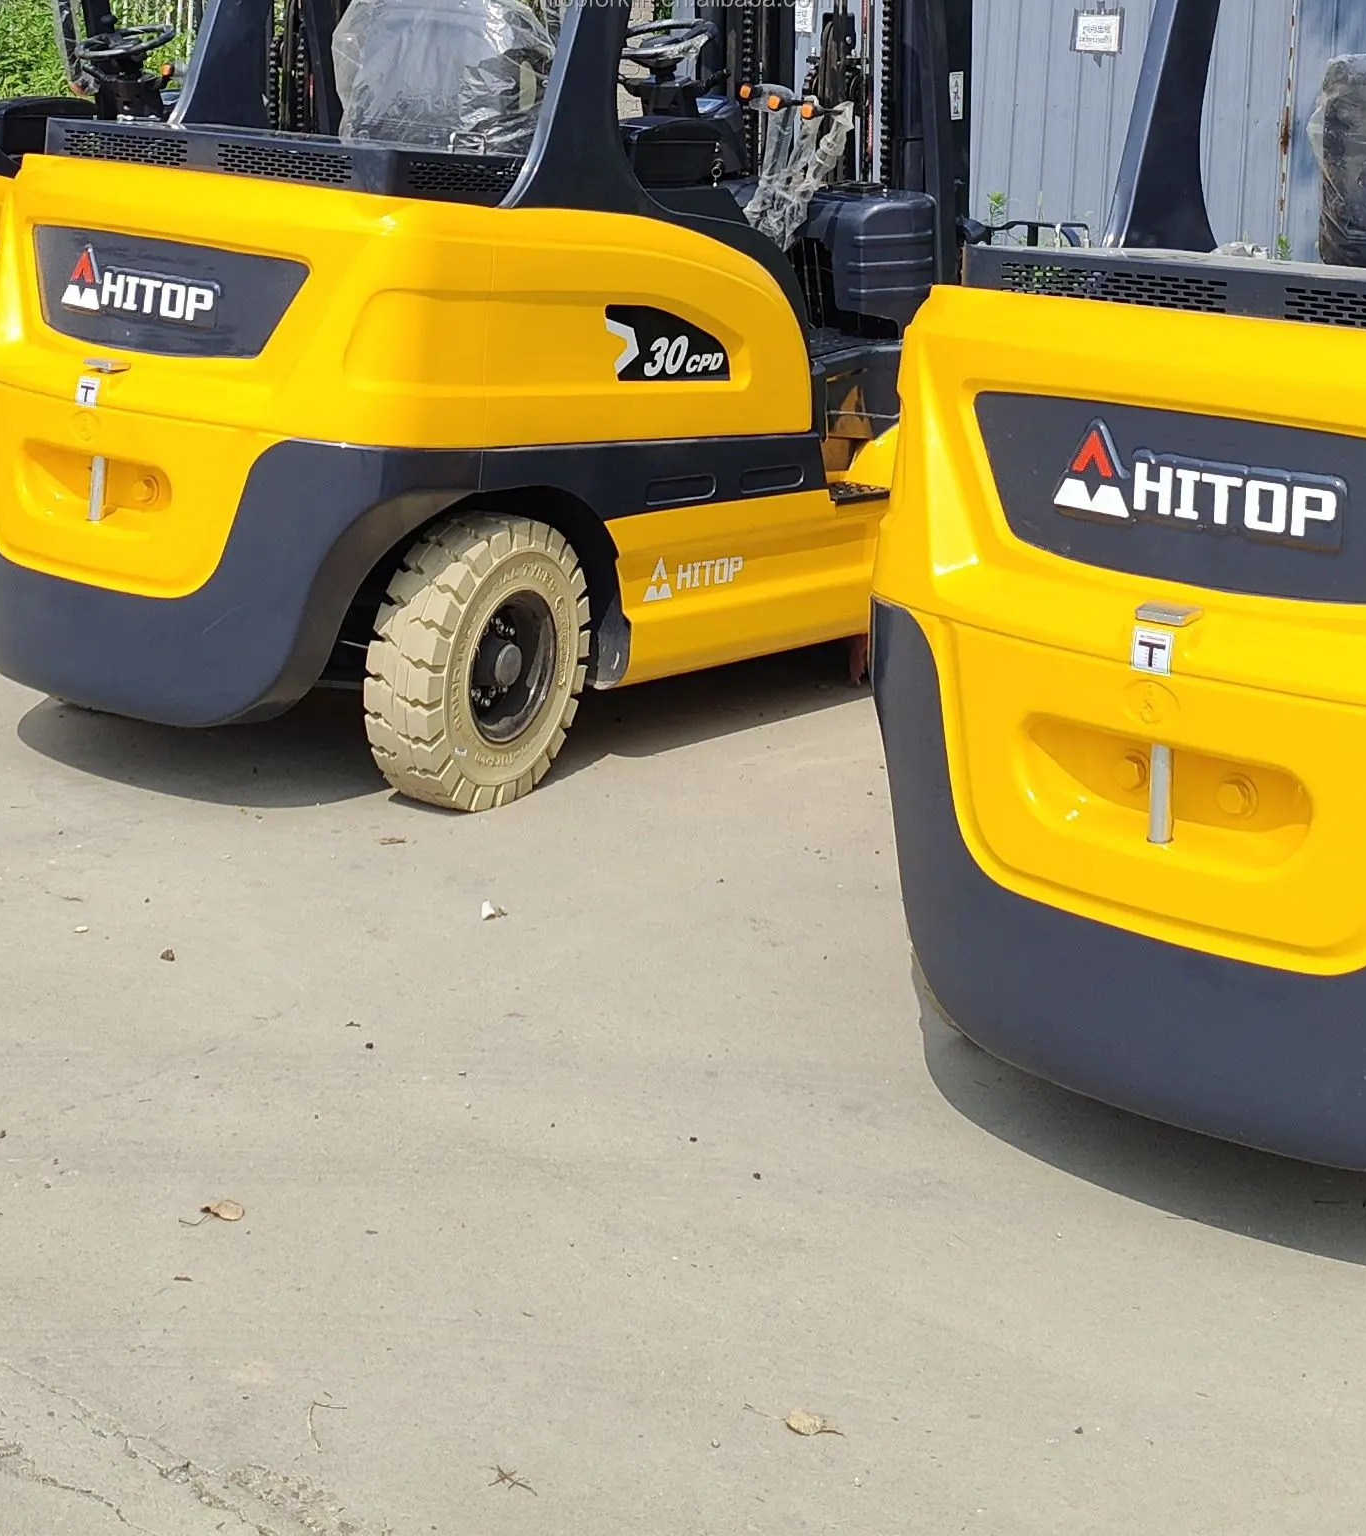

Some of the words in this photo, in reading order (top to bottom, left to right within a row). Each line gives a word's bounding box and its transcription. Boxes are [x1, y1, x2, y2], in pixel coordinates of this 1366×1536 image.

[101, 271, 214, 321] HITOP
[80, 384, 95, 403] T
[1133, 461, 1337, 537] HITOP
[676, 556, 743, 591] HITOP
[1138, 639, 1167, 668] T
